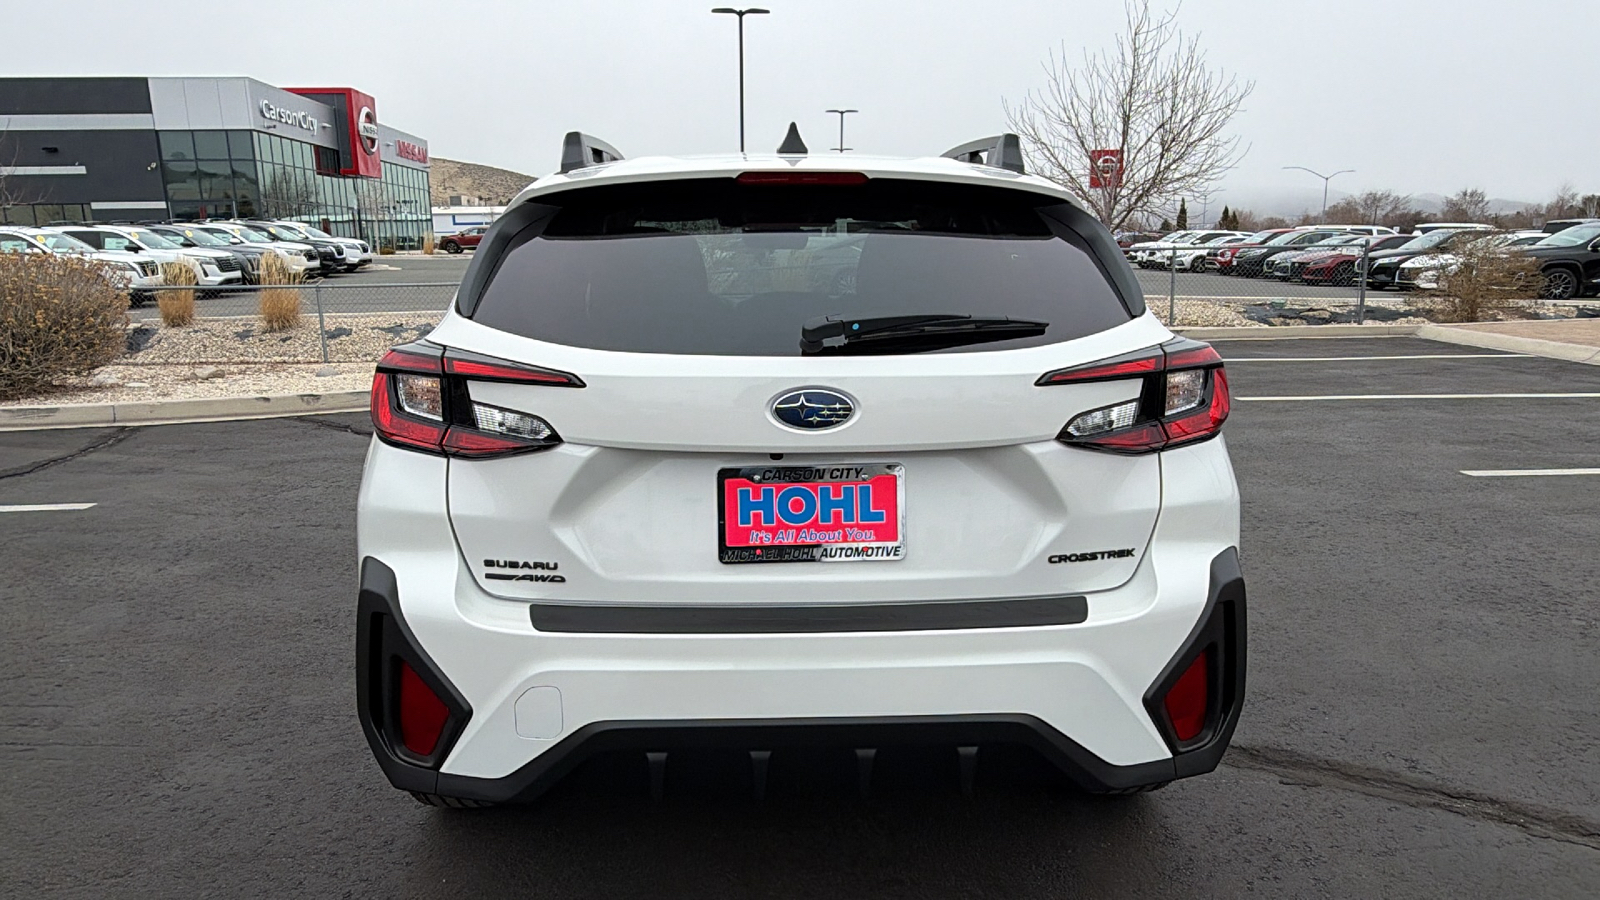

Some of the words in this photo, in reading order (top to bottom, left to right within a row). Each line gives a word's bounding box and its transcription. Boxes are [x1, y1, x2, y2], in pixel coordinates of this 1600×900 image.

[260, 99, 299, 127] Carson
[299, 111, 318, 136] City
[396, 140, 428, 164] NISSAN
[762, 468, 826, 481] CARSON
[829, 467, 863, 479] CITY
[737, 484, 886, 527] HOHL
[750, 530, 771, 543] It's
[774, 529, 795, 542] All
[797, 528, 843, 542] About
[845, 527, 876, 541] You.
[722, 549, 780, 562] MICHAEL
[782, 548, 816, 561] HOHL
[819, 545, 902, 559] AUTOMOTIVE
[1047, 548, 1136, 564] CROSSTREK
[483, 559, 558, 570] SUBARU
[514, 574, 566, 583] AWD
